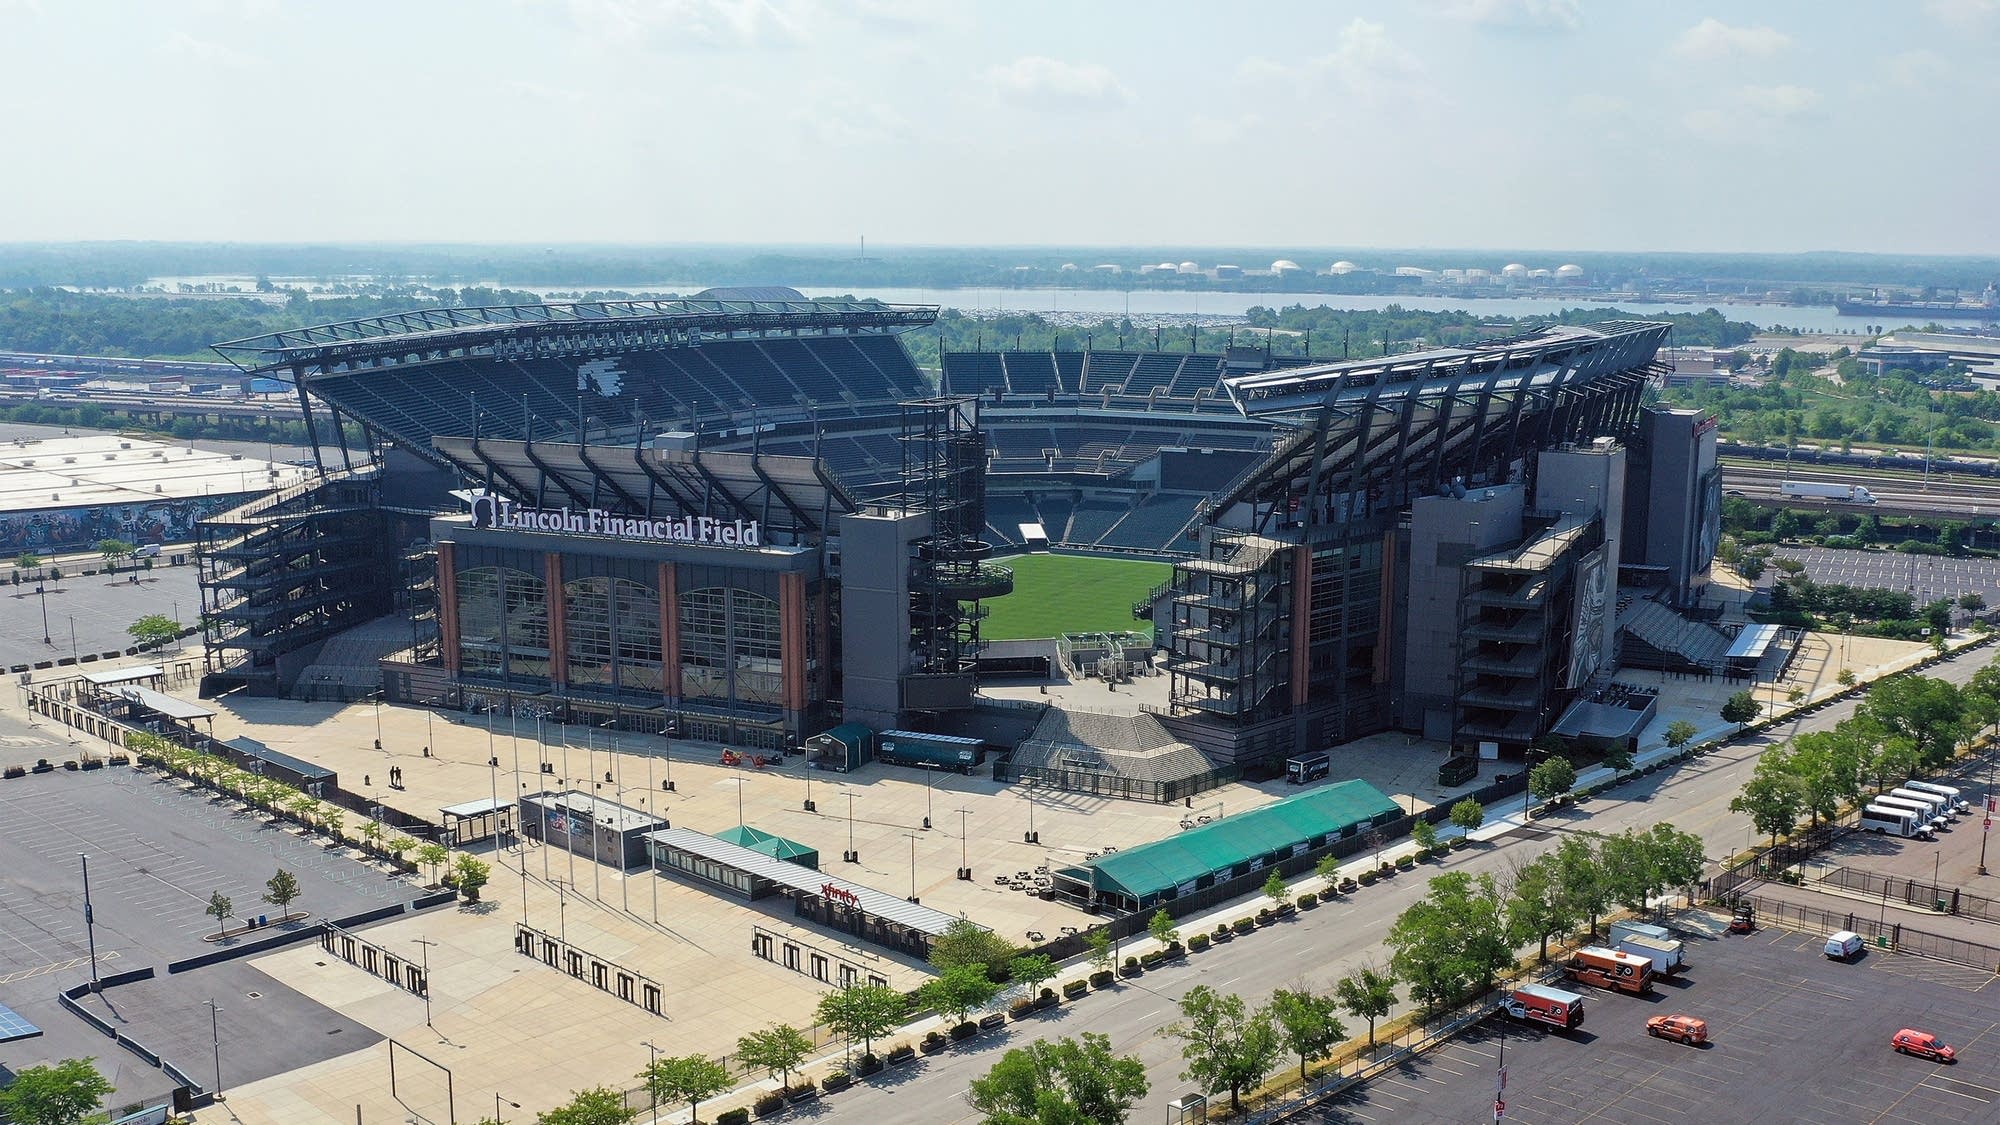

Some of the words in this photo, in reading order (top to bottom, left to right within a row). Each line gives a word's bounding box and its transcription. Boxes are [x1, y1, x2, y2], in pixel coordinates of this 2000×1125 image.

[501, 502, 585, 532] Lincoln
[588, 508, 694, 541] Financial
[698, 516, 759, 546] Field
[821, 882, 858, 908] xfinity
